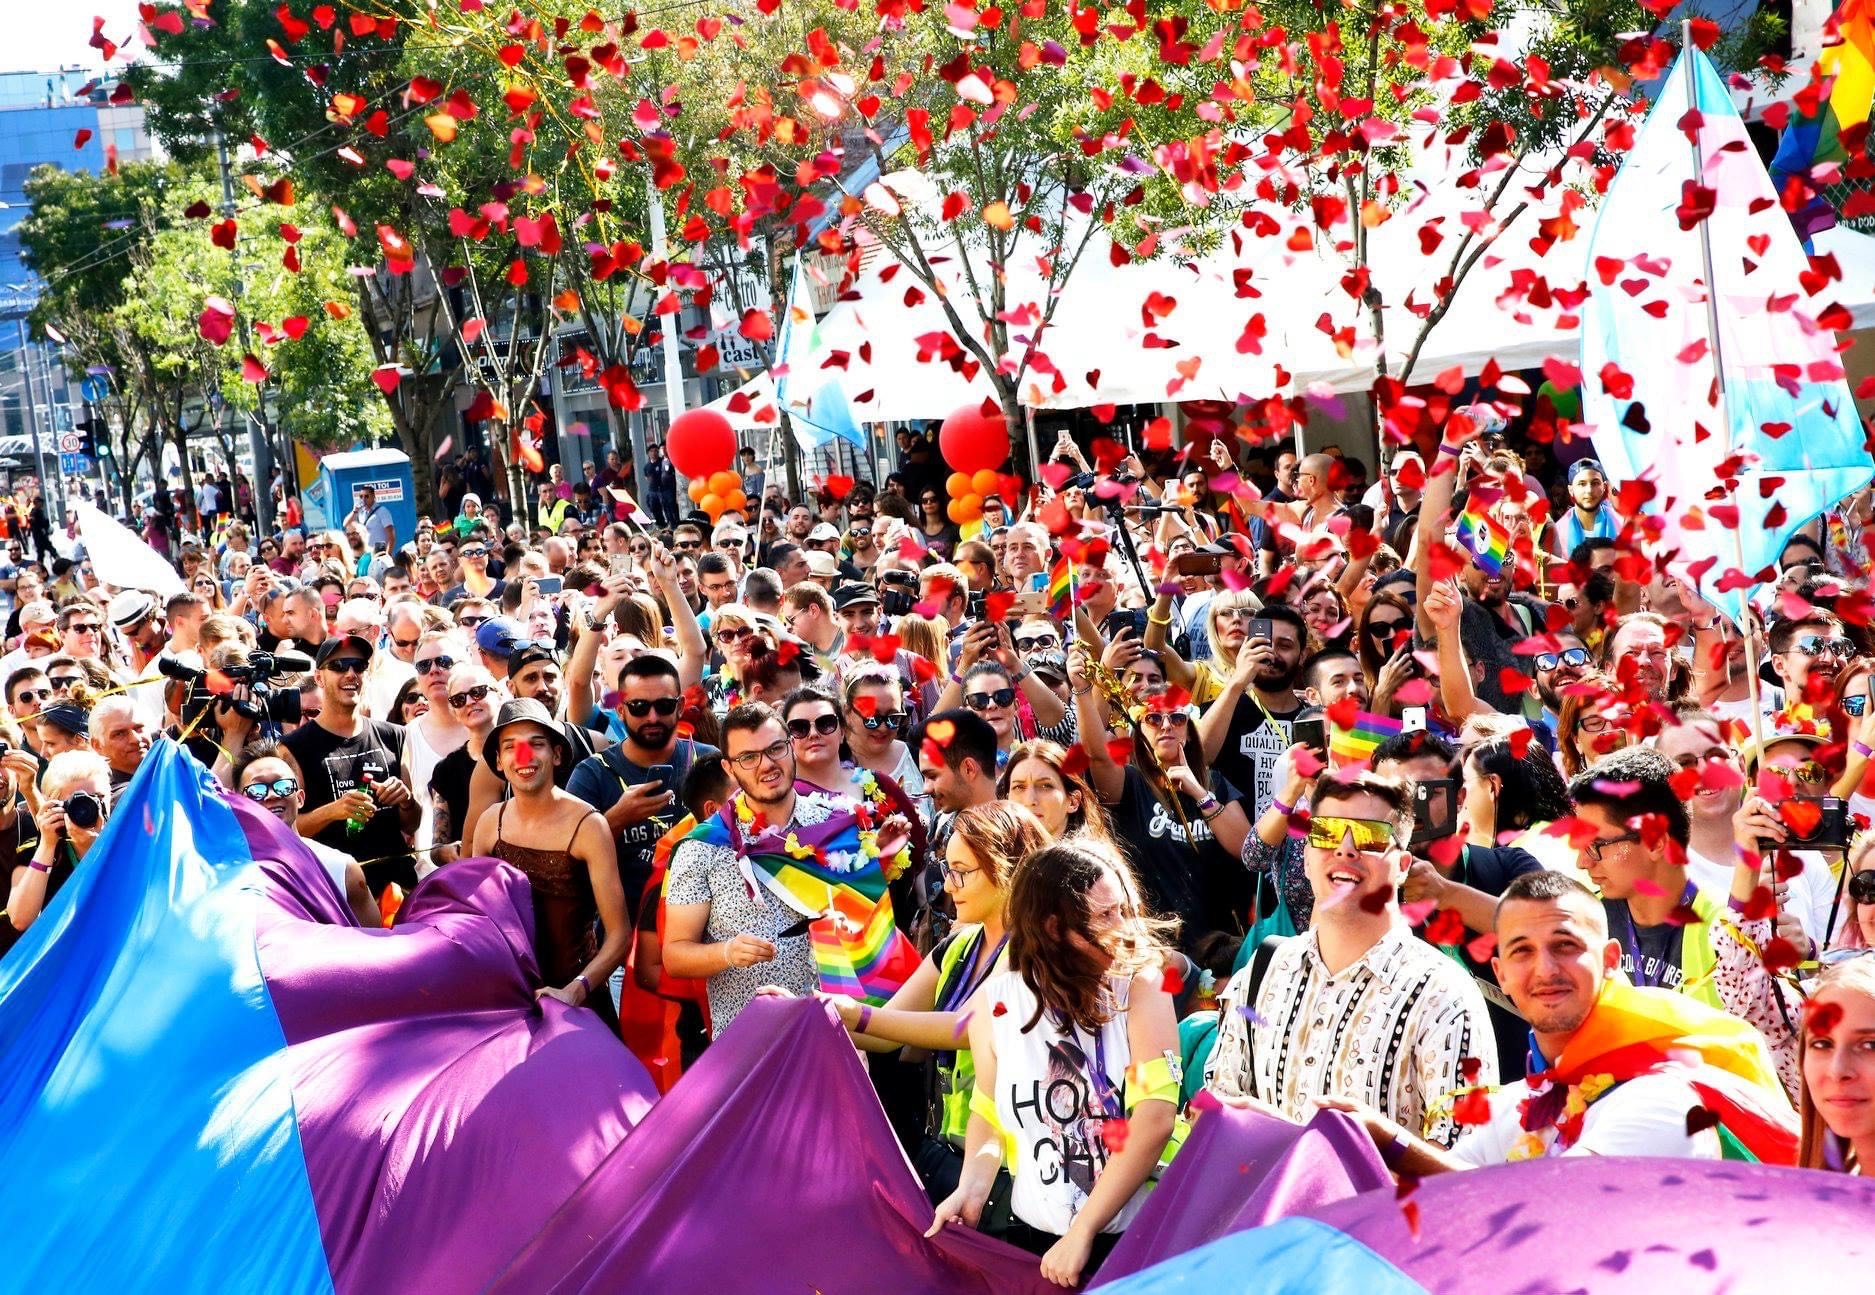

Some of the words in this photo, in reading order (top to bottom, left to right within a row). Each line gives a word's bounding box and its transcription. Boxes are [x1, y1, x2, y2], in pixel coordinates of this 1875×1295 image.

[66, 437, 78, 448] 30
[335, 779, 355, 789] love
[623, 825, 648, 844] LOS
